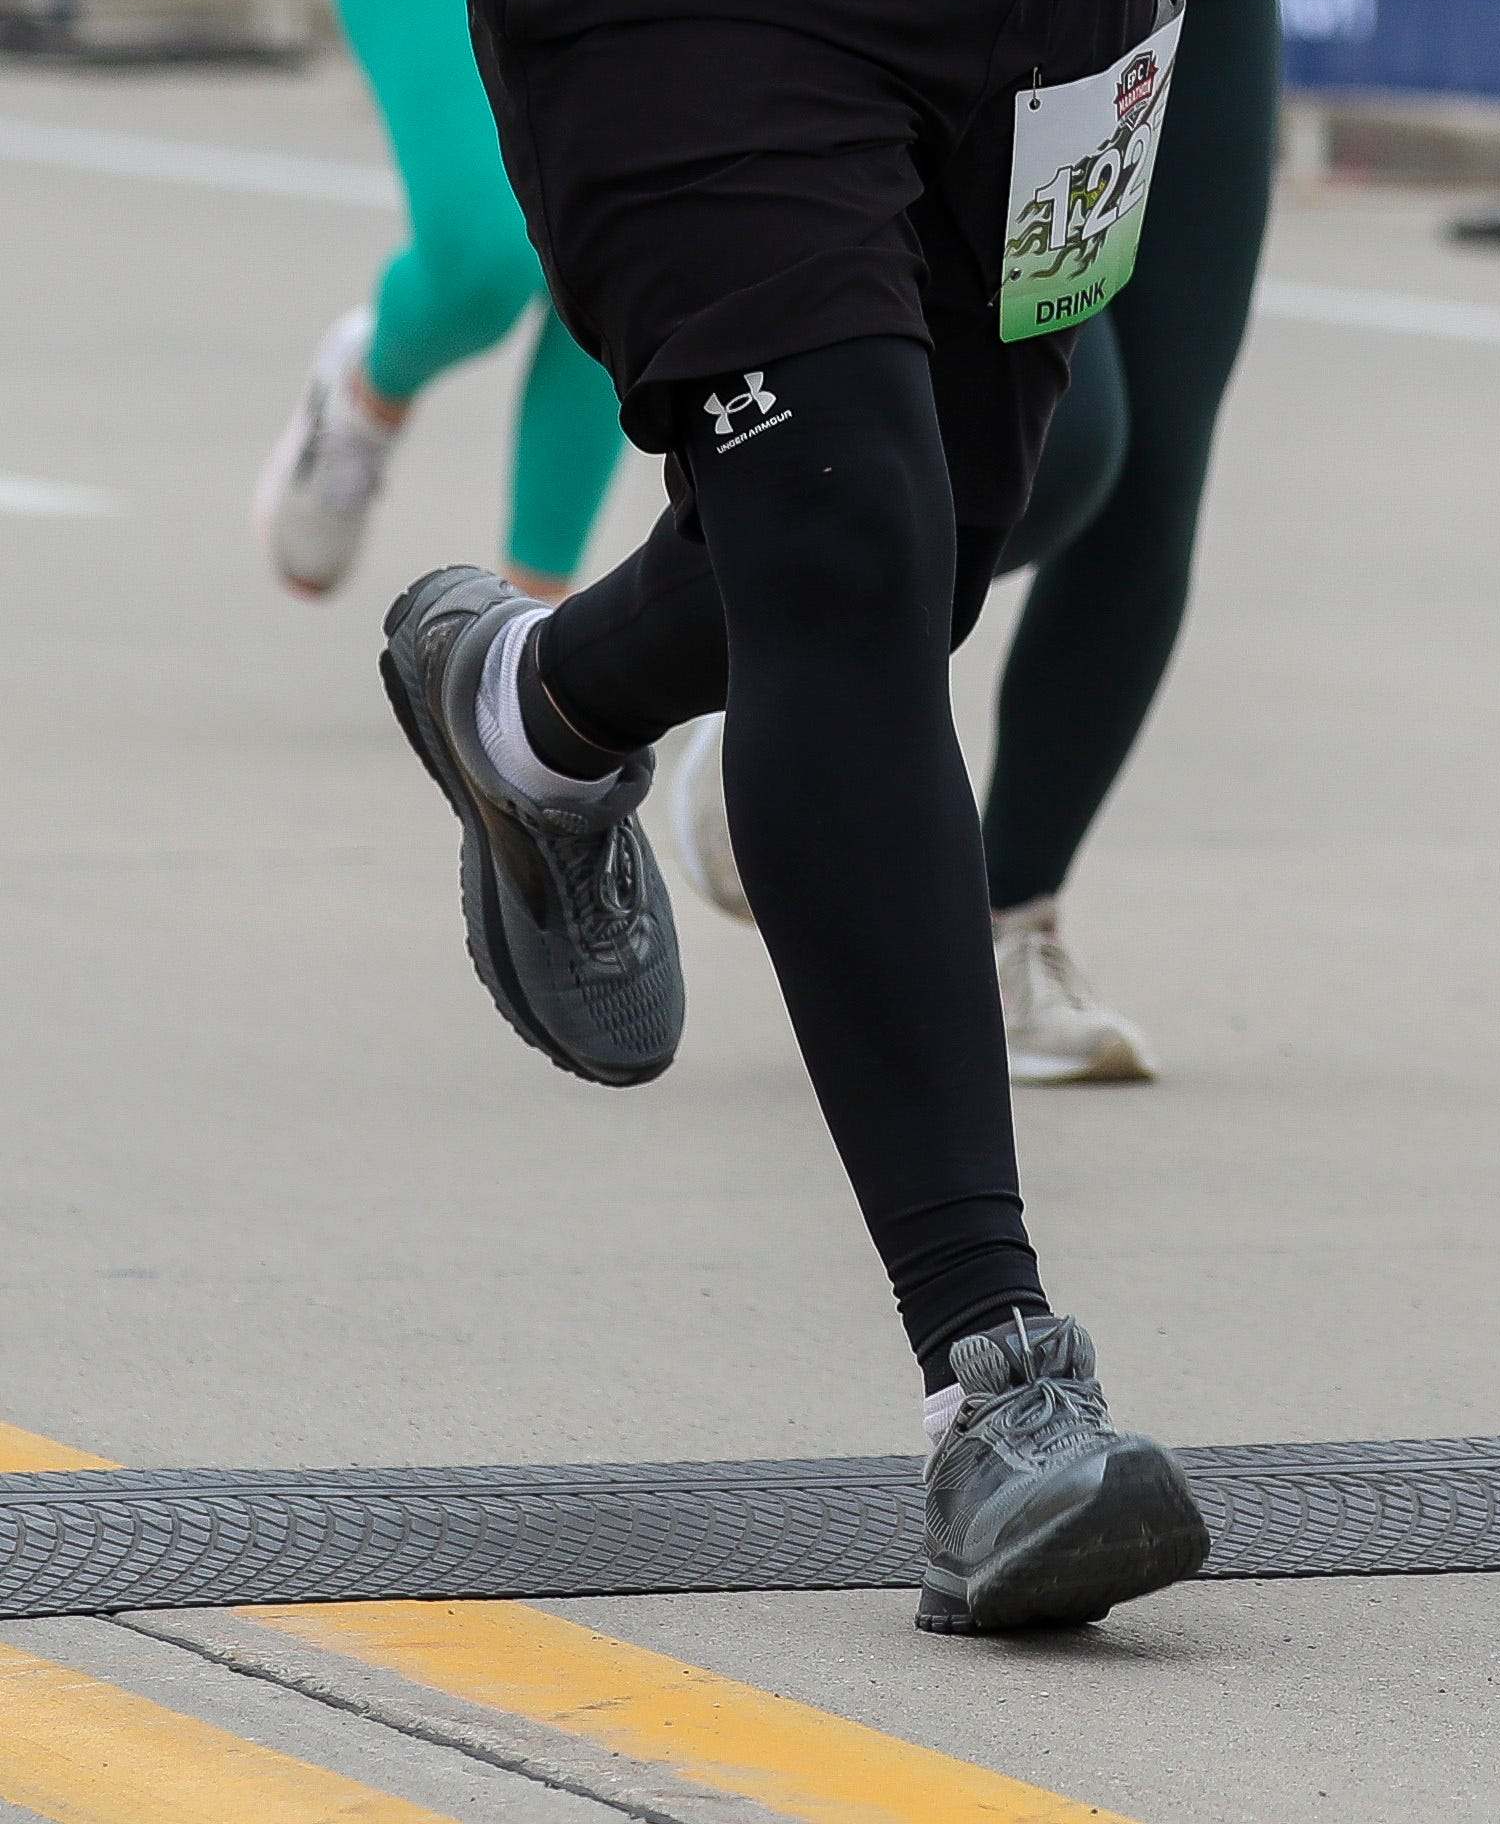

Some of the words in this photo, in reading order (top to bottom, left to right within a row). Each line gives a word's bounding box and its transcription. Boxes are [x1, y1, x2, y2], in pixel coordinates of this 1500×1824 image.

[1035, 277, 1106, 325] DRINK
[716, 432, 748, 454] UNDER
[748, 409, 793, 437] ARMOUR
